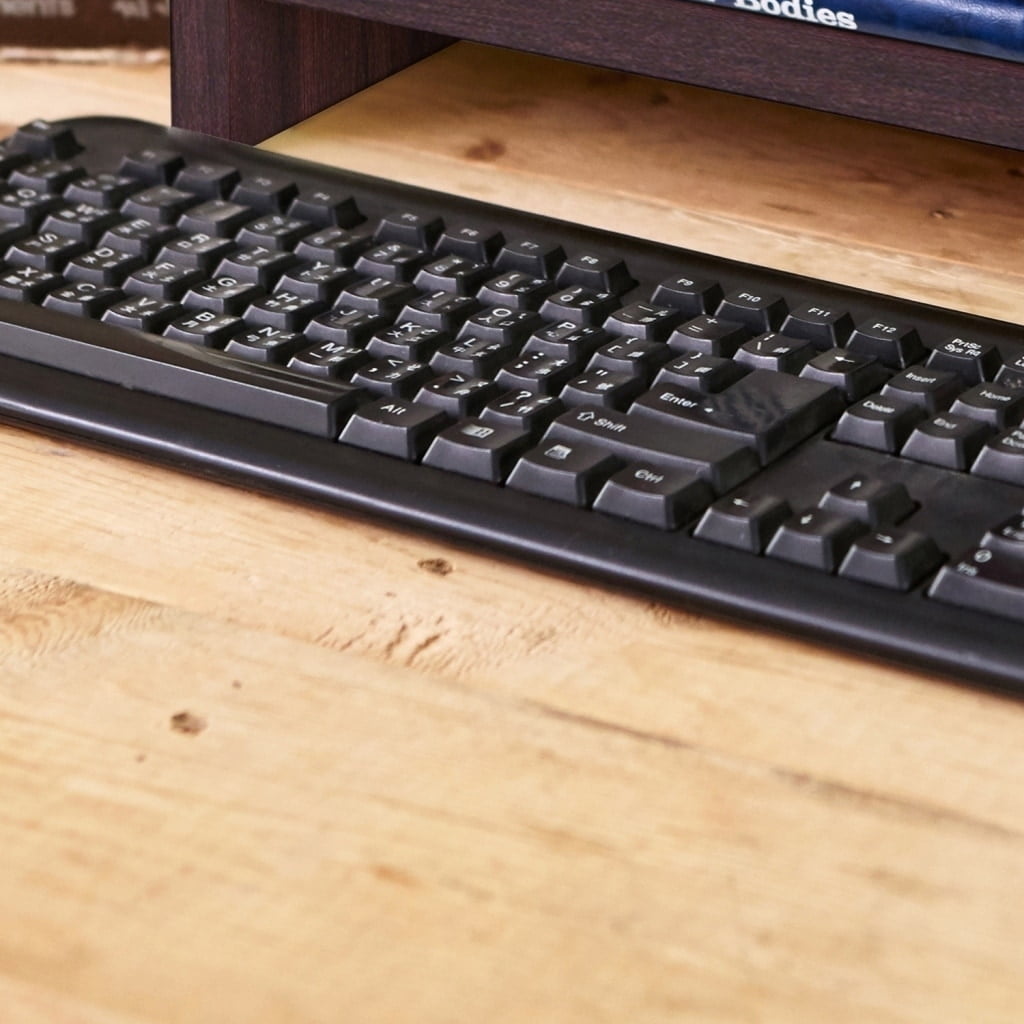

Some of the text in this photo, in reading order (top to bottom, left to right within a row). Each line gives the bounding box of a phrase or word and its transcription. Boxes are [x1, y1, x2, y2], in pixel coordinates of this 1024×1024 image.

[131, 219, 152, 229] E
[460, 228, 479, 236] F6
[40, 233, 58, 243] S
[190, 233, 211, 244] R
[252, 246, 269, 255] T
[520, 241, 539, 250] F7
[94, 247, 115, 257] D
[580, 255, 599, 265] F8
[155, 262, 176, 270] F
[312, 261, 330, 270] Y
[16, 267, 39, 278] X
[217, 277, 238, 287] G
[496, 280, 510, 288] 9
[676, 278, 694, 287] F9
[76, 283, 97, 292] C
[139, 297, 158, 306] V
[276, 292, 299, 303] H
[738, 292, 761, 303] F10
[195, 311, 216, 322] B
[807, 307, 831, 319] F11
[400, 322, 422, 332] K
[557, 321, 577, 329] P
[872, 322, 897, 334] F12
[258, 326, 281, 337] N
[463, 338, 477, 347] L
[320, 342, 345, 354] M
[905, 371, 937, 384] Insert
[516, 390, 532, 400] ?
[979, 390, 1012, 402] Home
[659, 392, 699, 409] Enter
[380, 403, 406, 416] Alt
[594, 418, 627, 433] Shift
[634, 468, 664, 484] Ctrl
